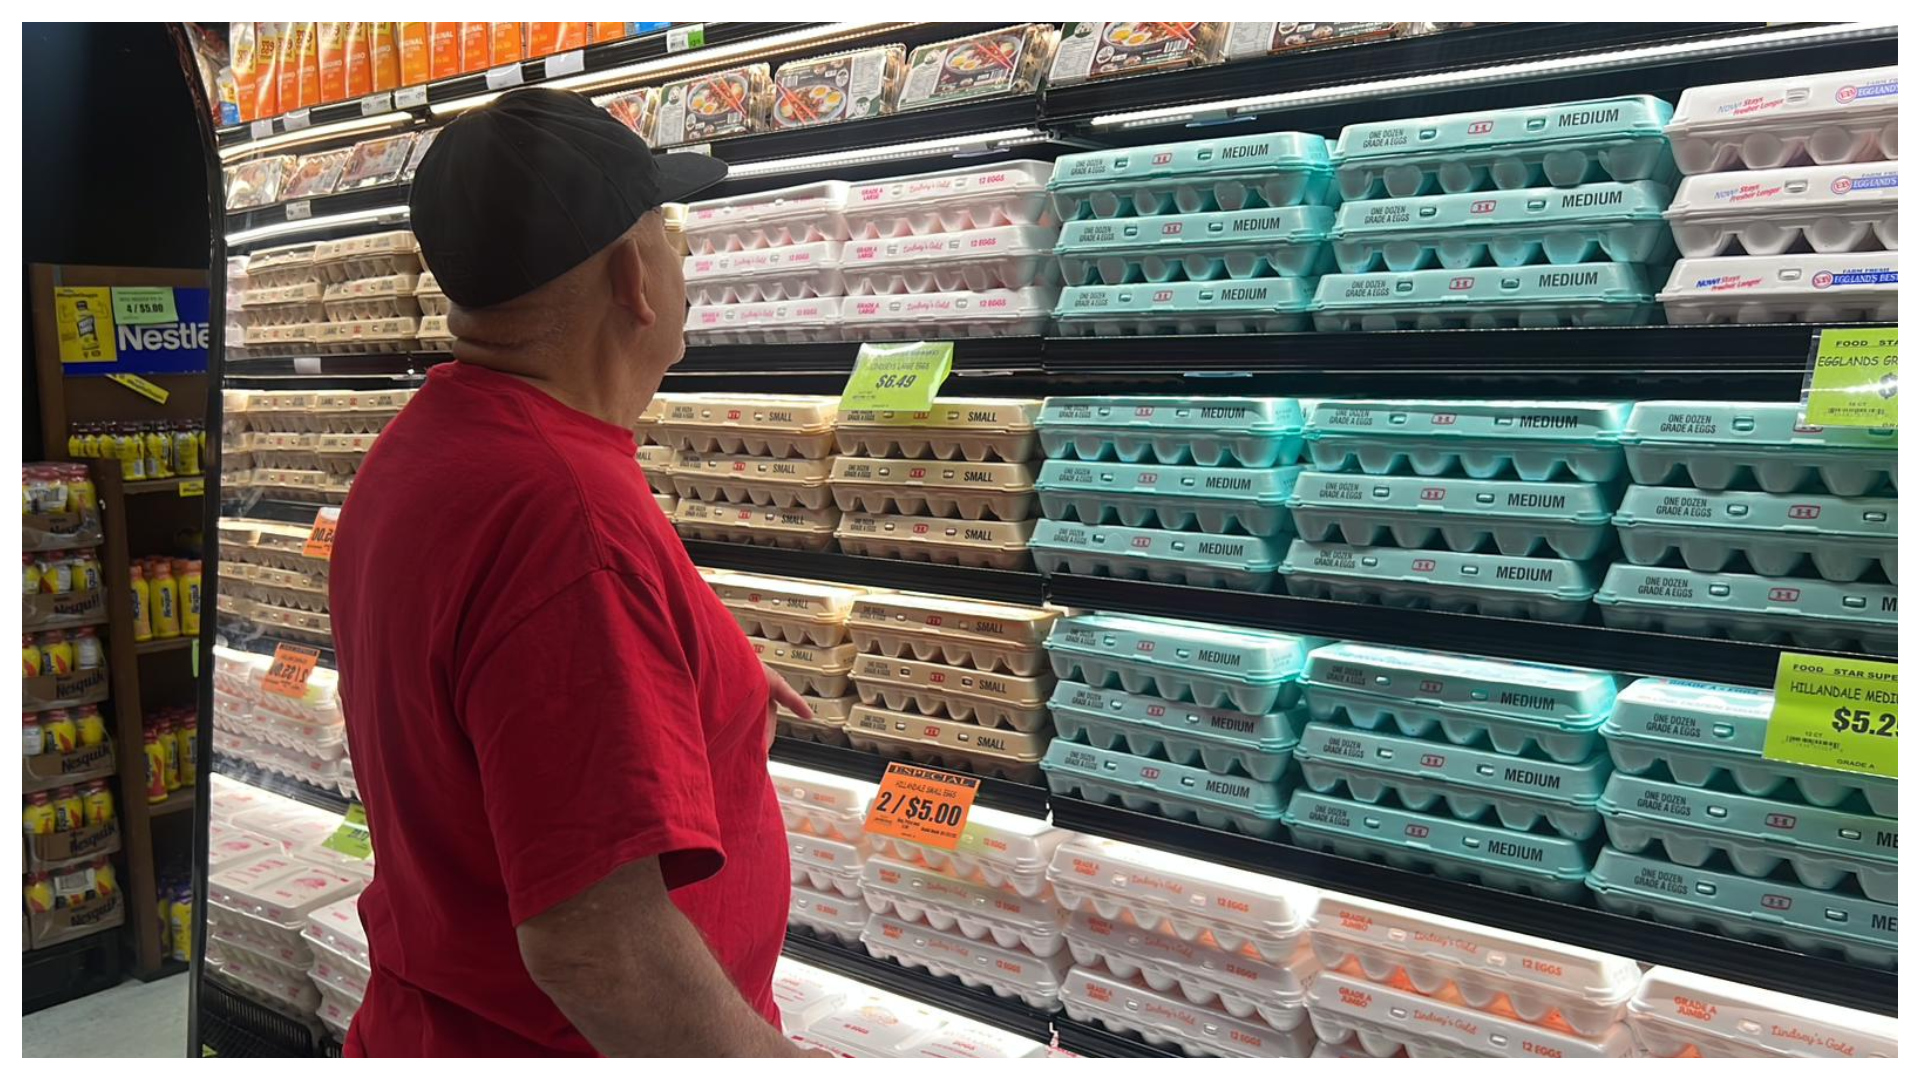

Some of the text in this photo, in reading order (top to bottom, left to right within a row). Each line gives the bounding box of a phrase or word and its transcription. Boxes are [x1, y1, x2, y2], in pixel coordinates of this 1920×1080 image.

[1558, 109, 1619, 127] MEDIUM
[1222, 144, 1269, 159] MEDIUM
[987, 174, 1005, 183] EGGS
[1562, 191, 1622, 208] MEDIUM
[1233, 217, 1280, 232] MEDIUM
[978, 238, 997, 246] EGGS
[1538, 272, 1599, 288] MEDIUM
[1221, 288, 1267, 301] MEDIUM
[126, 304, 133, 313] 4
[140, 303, 164, 313] $5.00
[1817, 356, 1879, 367] EGGLANDS
[876, 374, 917, 389] $6.49
[769, 412, 792, 422] SMALL
[968, 412, 997, 423] SMALL
[1201, 407, 1245, 420] MEDIUM
[1519, 415, 1578, 429] MEDIUM
[773, 464, 796, 474] SMALL
[964, 471, 993, 482] SMALL
[1205, 476, 1251, 491] MEDIUM
[1507, 493, 1566, 509] MEDIUM
[781, 514, 805, 525] SMALL
[965, 529, 993, 541] SMALL
[1198, 542, 1243, 557] MEDIUM
[1496, 565, 1553, 582] MEDIUM
[787, 597, 809, 610] SMALL
[976, 621, 1005, 634] SMALL
[791, 649, 813, 662] SMALL
[1198, 650, 1241, 666] MEDIUM
[1793, 664, 1824, 673] FOOD
[1834, 668, 1864, 678] STAR
[979, 679, 1007, 694] SMALL
[1790, 681, 1898, 704] HILLANDALE MEDI
[1500, 692, 1555, 711] MEDIUM
[1210, 716, 1255, 733] MEDIUM
[1831, 706, 1898, 737] $5.2
[977, 736, 1006, 751] SMALL
[1836, 758, 1867, 768] GRADE
[891, 765, 970, 786] ESPECIAL
[1504, 768, 1560, 789] MEDIUM
[1206, 780, 1250, 799] MEDIUM
[876, 791, 892, 812] 2
[905, 796, 962, 827] $5.00
[1488, 840, 1543, 862] MEDIUM
[1340, 911, 1366, 925] GRADE
[1522, 958, 1562, 976] 12 EGGS
[1338, 987, 1365, 1000] GRADE
[1674, 996, 1706, 1011] GRADE
[1677, 1006, 1711, 1021] JUMBO
[1522, 1041, 1532, 1052] 12
[1771, 1025, 1855, 1056] Lindsey's Gold
